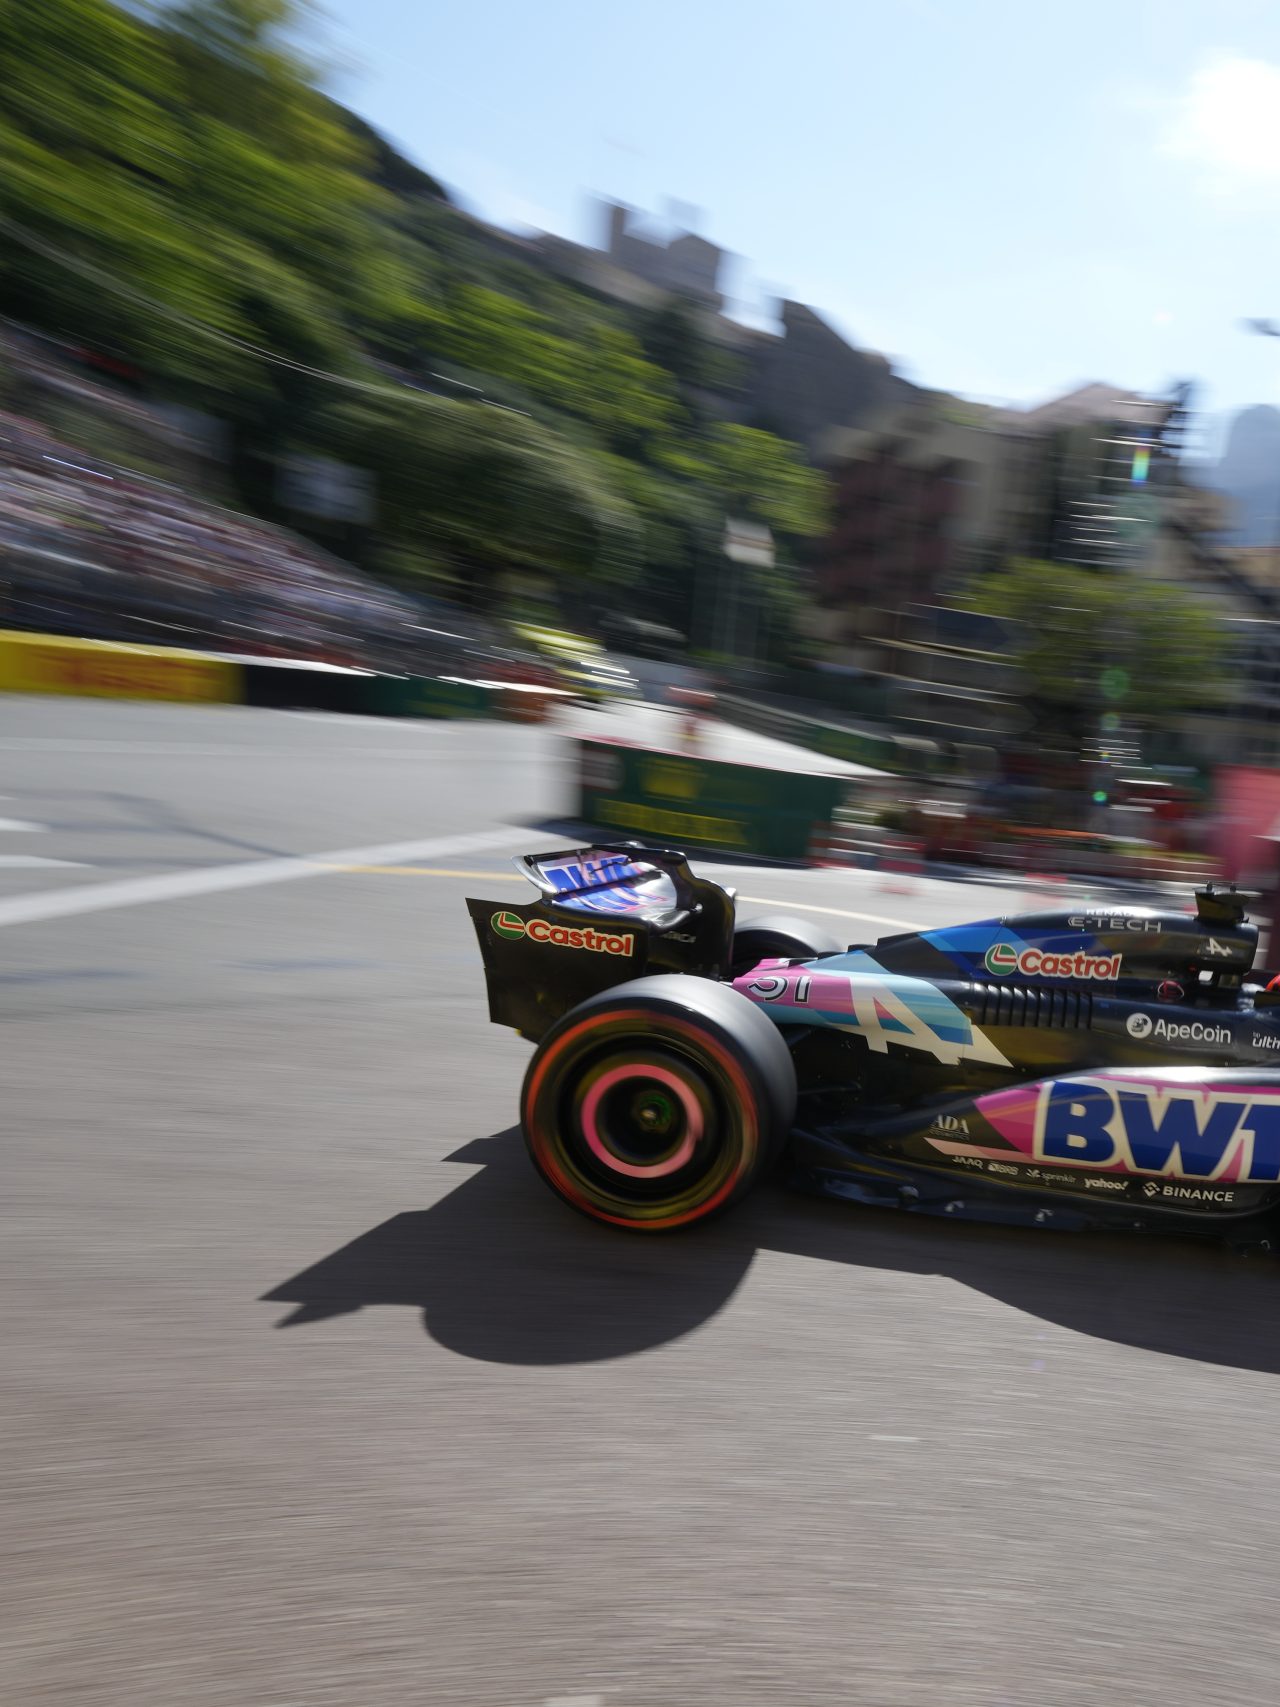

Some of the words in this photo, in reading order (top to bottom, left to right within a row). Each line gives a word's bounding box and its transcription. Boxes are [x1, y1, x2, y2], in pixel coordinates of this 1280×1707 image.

[1069, 916, 1162, 934] E-TECH
[526, 918, 635, 957] Castrol
[1016, 947, 1123, 981] Castrol
[1153, 1017, 1232, 1045] ApeCoin
[929, 1114, 970, 1134] ADA
[1084, 1177, 1129, 1191] yahoo!
[1162, 1185, 1235, 1202] BINANCE
